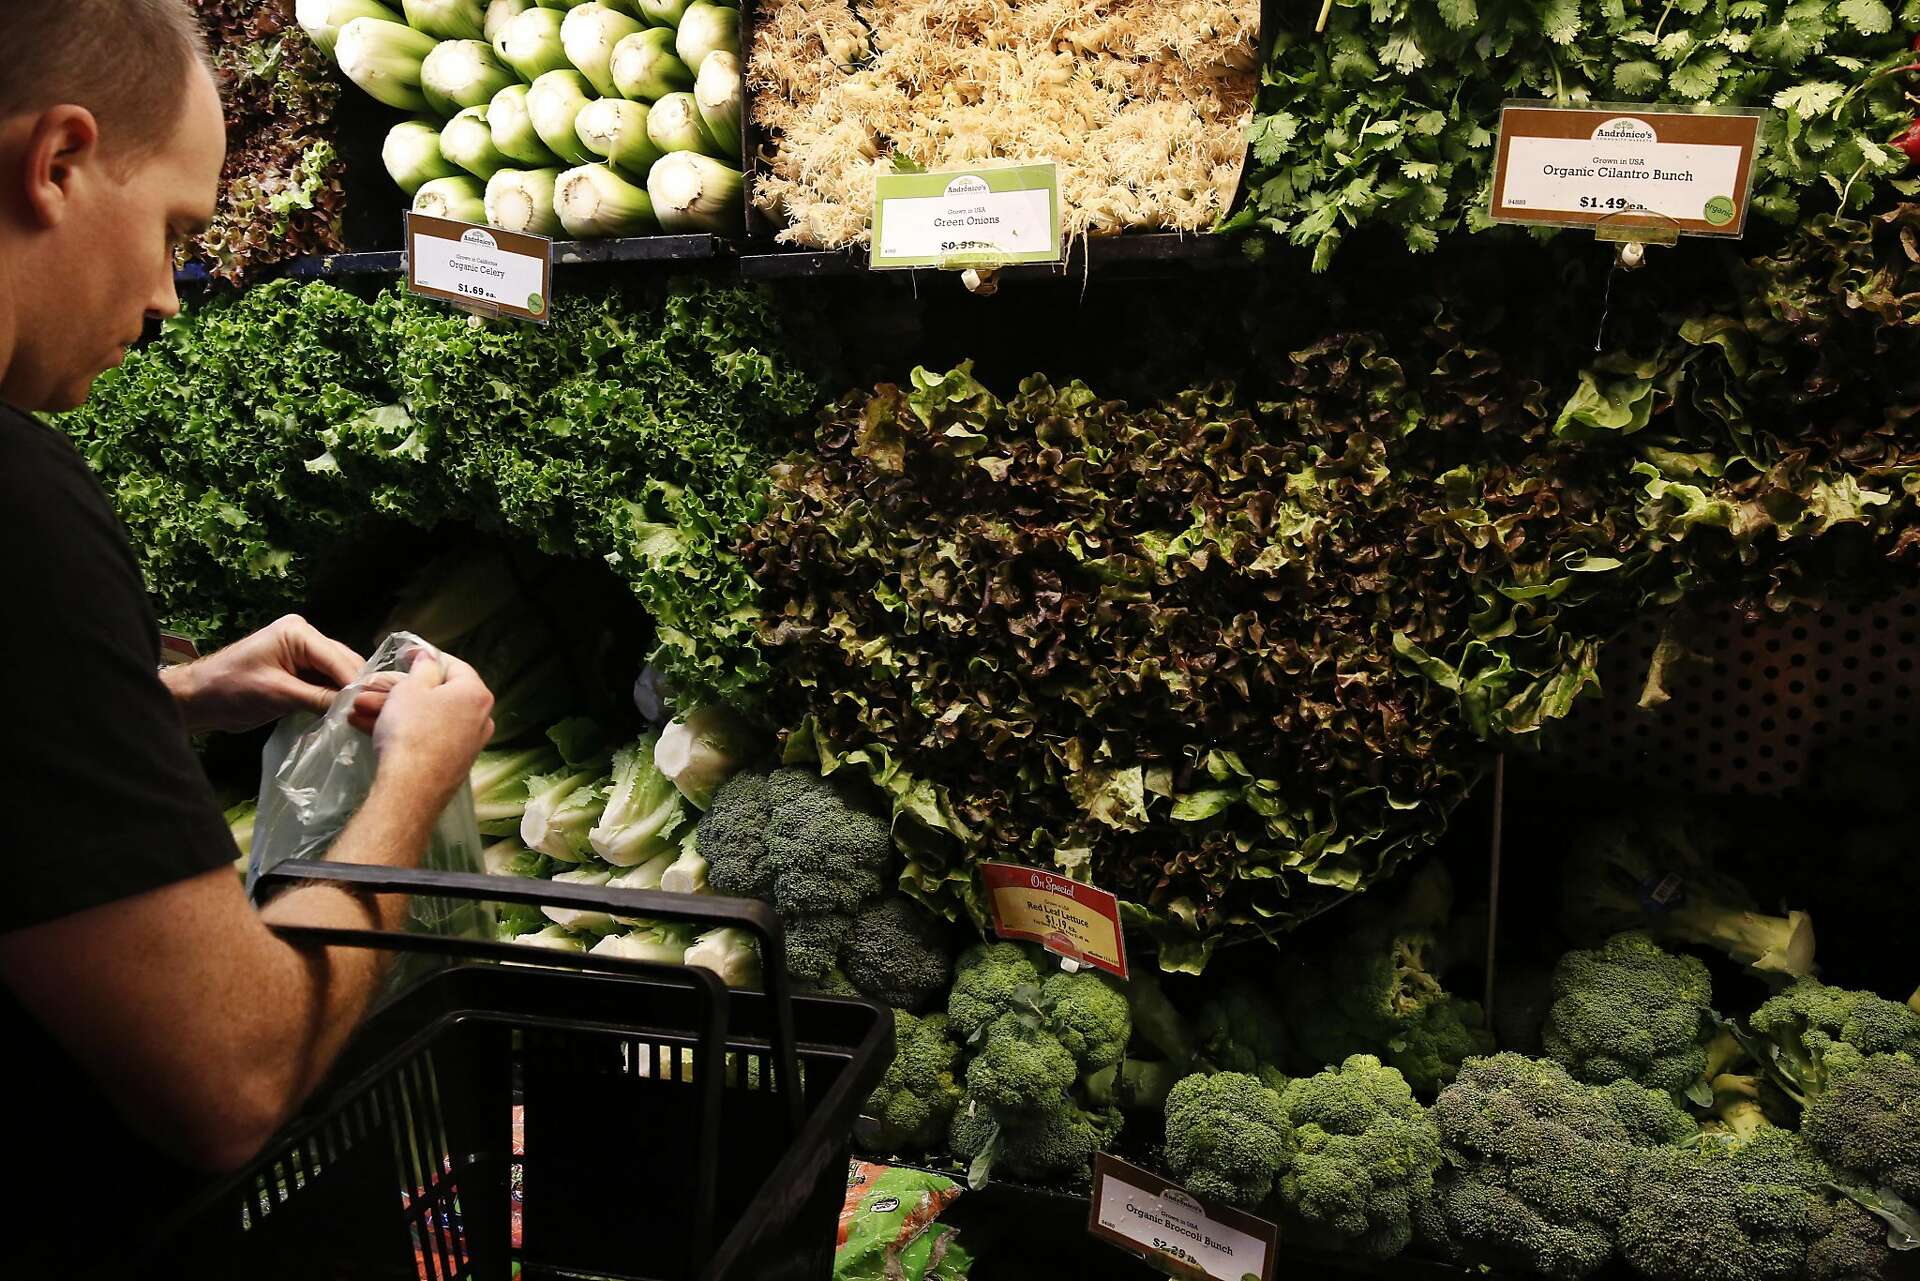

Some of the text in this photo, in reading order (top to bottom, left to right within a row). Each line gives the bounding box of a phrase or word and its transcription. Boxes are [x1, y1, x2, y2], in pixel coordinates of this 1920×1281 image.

[1592, 156, 1618, 165] Grown
[1629, 158, 1645, 166] USA
[1543, 164, 1693, 182] Organic Cilantro Bunch
[1579, 196, 1648, 211] $1.49 ea.
[1704, 202, 1734, 219] organic
[934, 215, 1000, 228] Green Onions
[449, 260, 505, 280] Organic Celery
[458, 283, 497, 299] $1.69 ea.
[1030, 873, 1075, 898] On Special
[1027, 901, 1043, 912] Red
[1044, 904, 1061, 917] Leaf
[1061, 910, 1089, 928] Lettuce
[1045, 914, 1067, 929] $1.19
[1160, 1211, 1179, 1223] Grown
[1186, 1220, 1199, 1231] USA
[1126, 1203, 1234, 1257] Organic Broccoli Bunch
